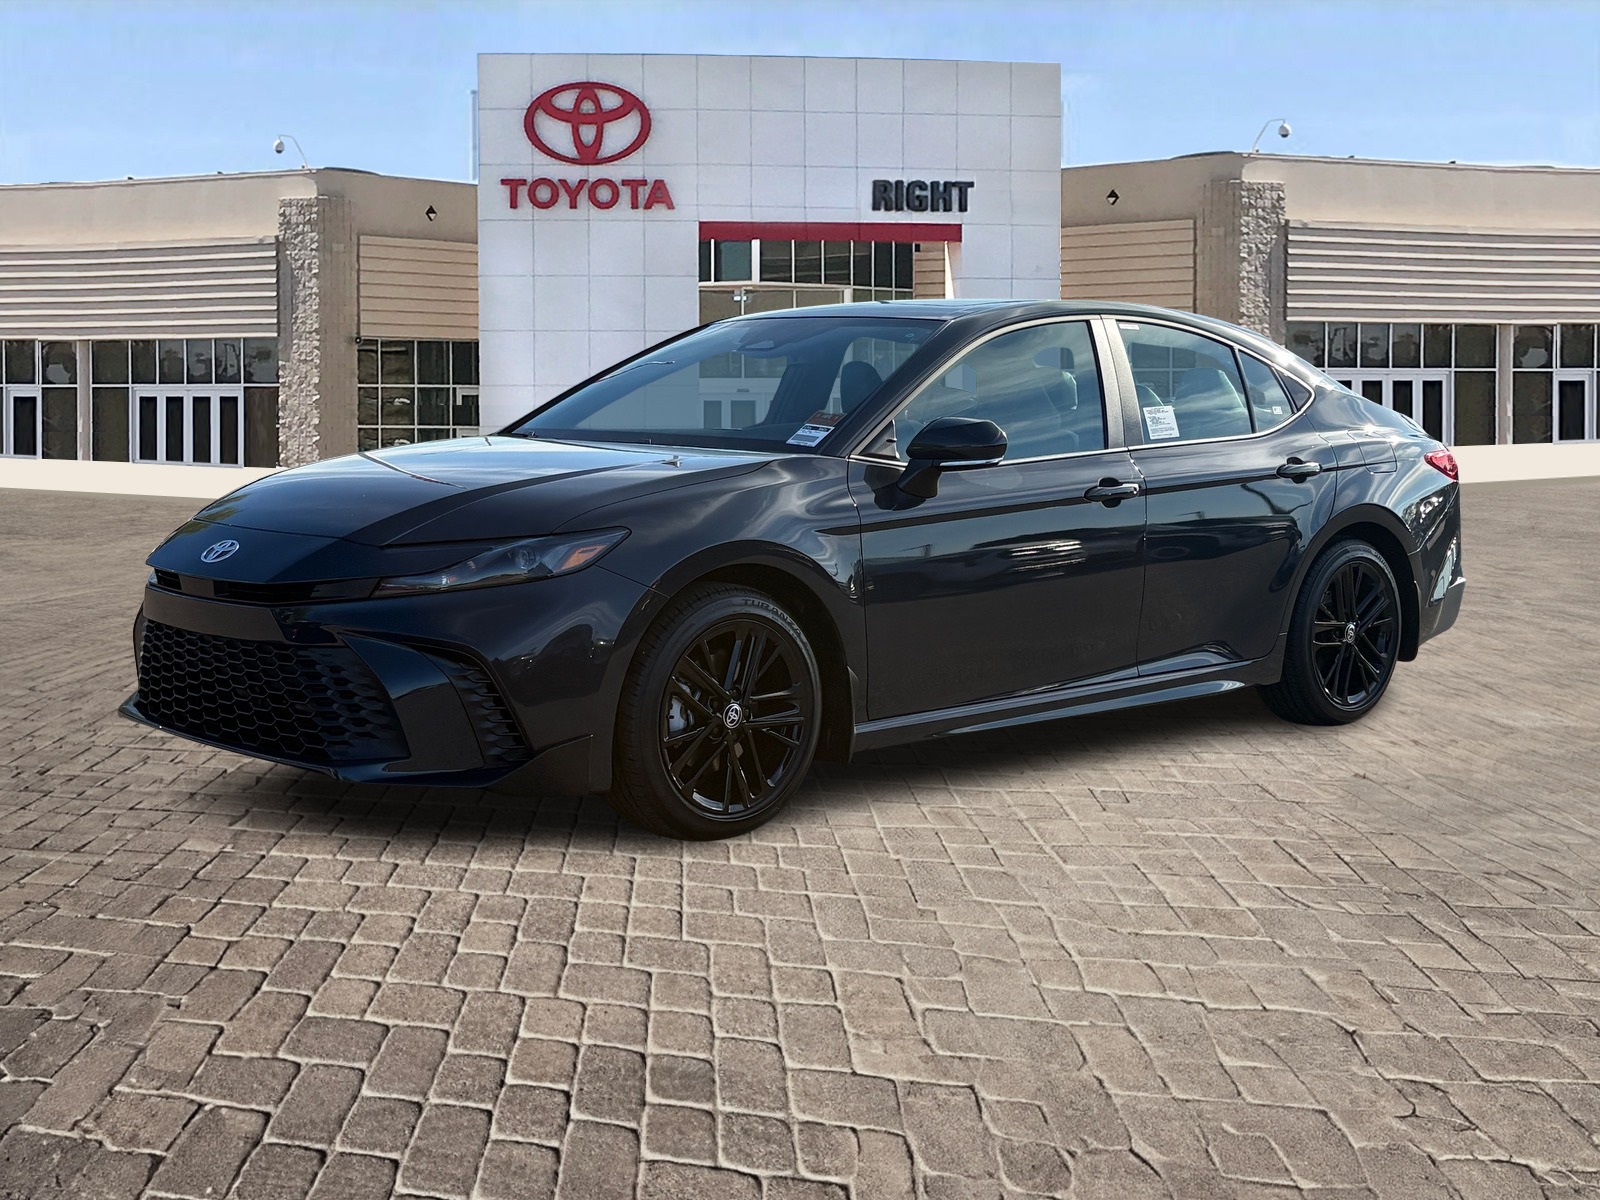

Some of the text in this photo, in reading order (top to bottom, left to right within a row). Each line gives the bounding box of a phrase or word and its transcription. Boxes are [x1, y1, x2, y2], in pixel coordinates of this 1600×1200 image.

[500, 177, 675, 210] TOYOTA
[872, 179, 975, 212] RIGHT
[741, 598, 802, 637] TURANZA
